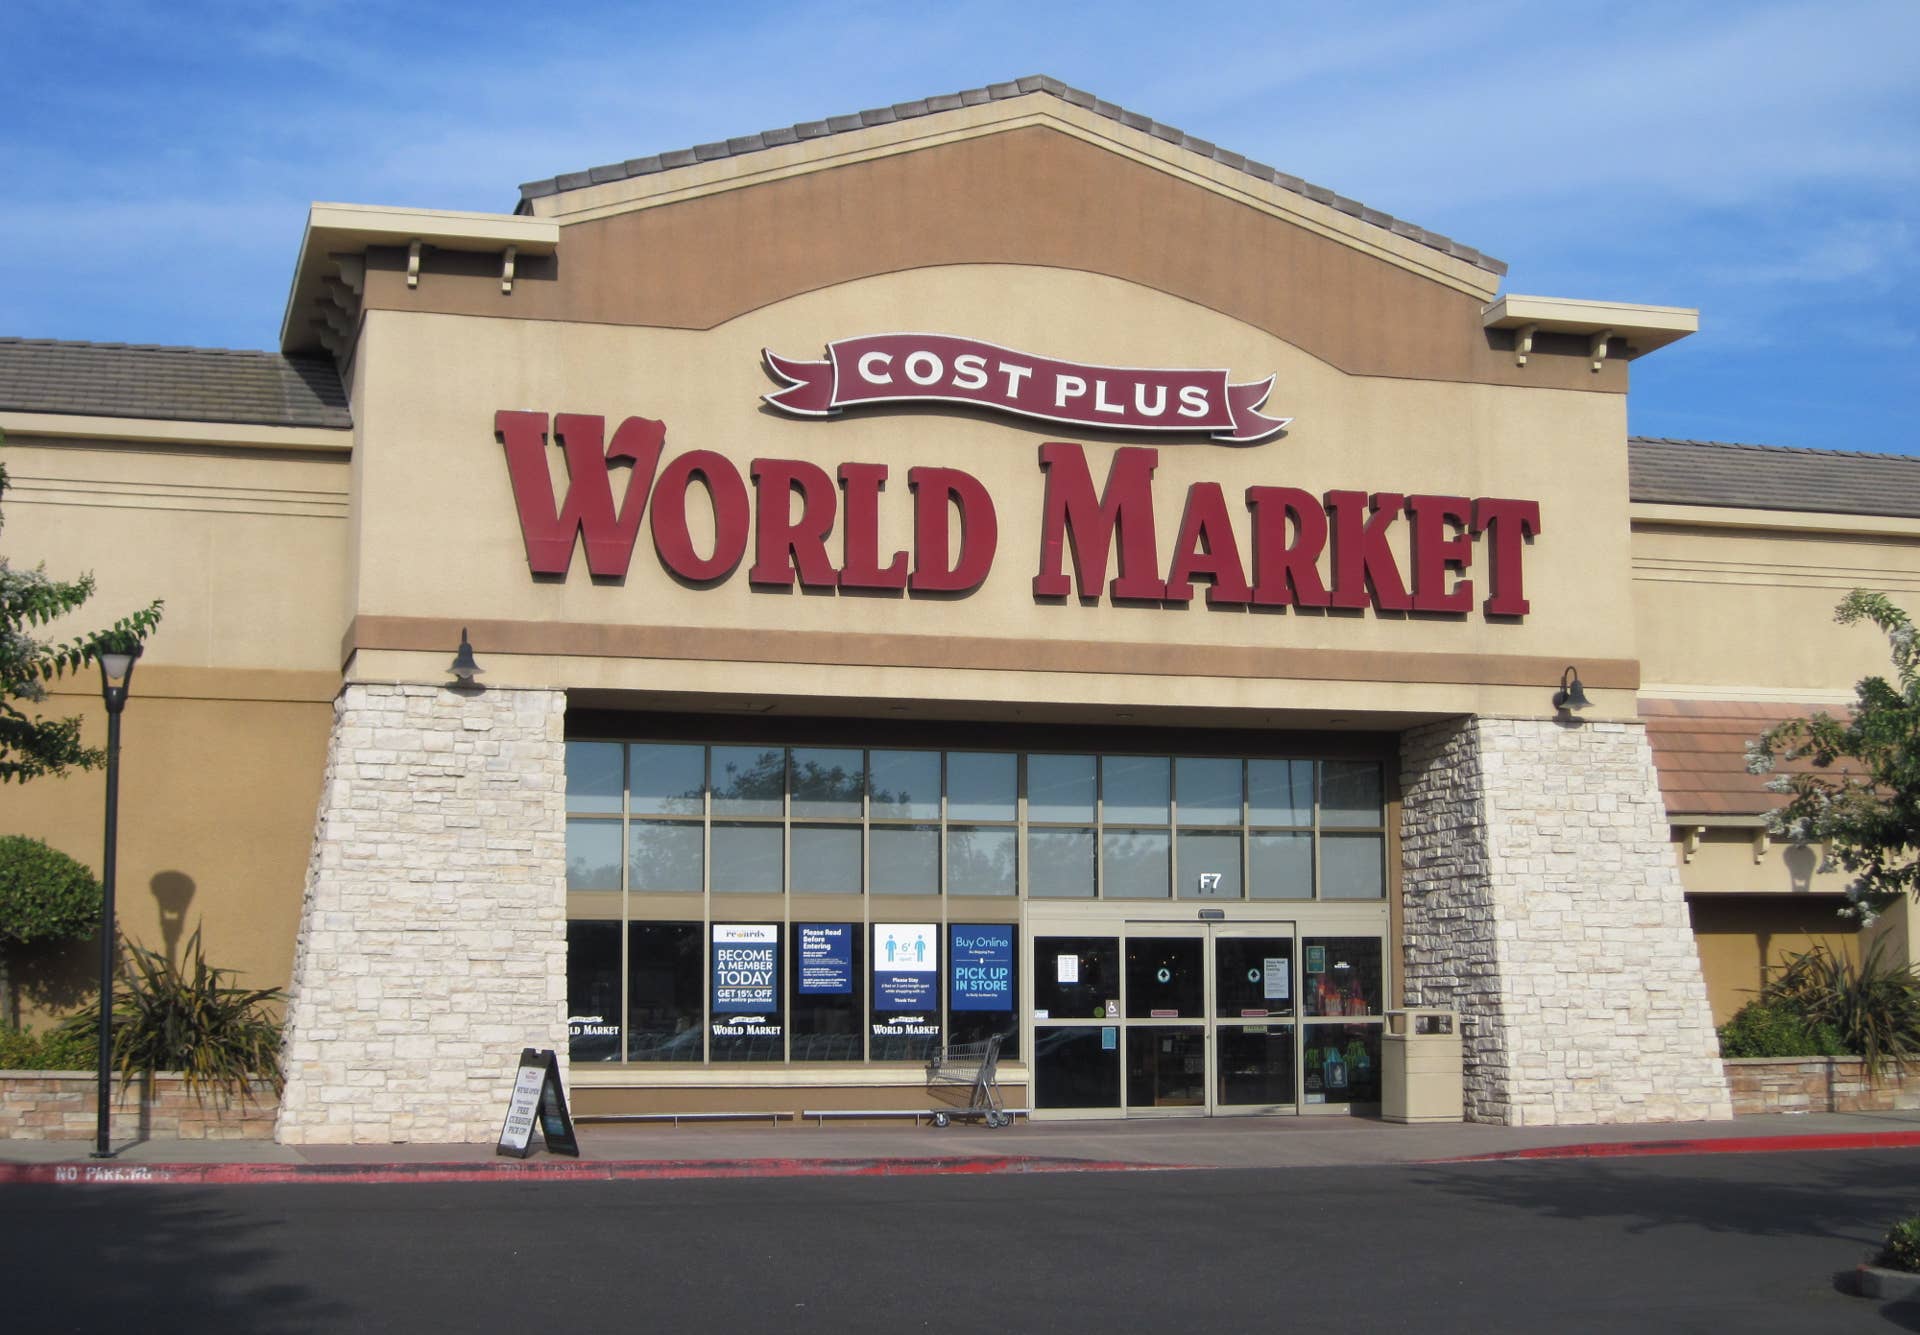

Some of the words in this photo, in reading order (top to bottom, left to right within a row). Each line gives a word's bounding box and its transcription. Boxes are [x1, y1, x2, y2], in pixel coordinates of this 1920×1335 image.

[857, 350, 1033, 399] COST
[1054, 373, 1210, 418] PLUS
[494, 409, 998, 595] WORLD
[1032, 441, 1541, 618] MARKET
[1199, 872, 1222, 889] F7
[803, 943, 831, 951] Entering
[956, 937, 974, 949] Buy
[976, 937, 1008, 947] Online
[718, 950, 773, 961] BECOME
[717, 961, 726, 970] A
[728, 961, 773, 970] MEMBER
[717, 971, 773, 985] TODAY
[956, 967, 987, 979] PICK
[990, 967, 1008, 979] UP
[956, 980, 967, 991] IN
[970, 980, 1007, 991] STORE
[717, 989, 735, 998] GET
[737, 989, 753, 998] 15%
[754, 989, 772, 998] OFF
[583, 1024, 619, 1035] MARKET
[712, 1024, 744, 1035] WORLD
[746, 1024, 781, 1035] MARKET
[872, 1024, 903, 1035] WORLD
[905, 1024, 939, 1035] MARKET
[56, 1166, 78, 1181] NO
